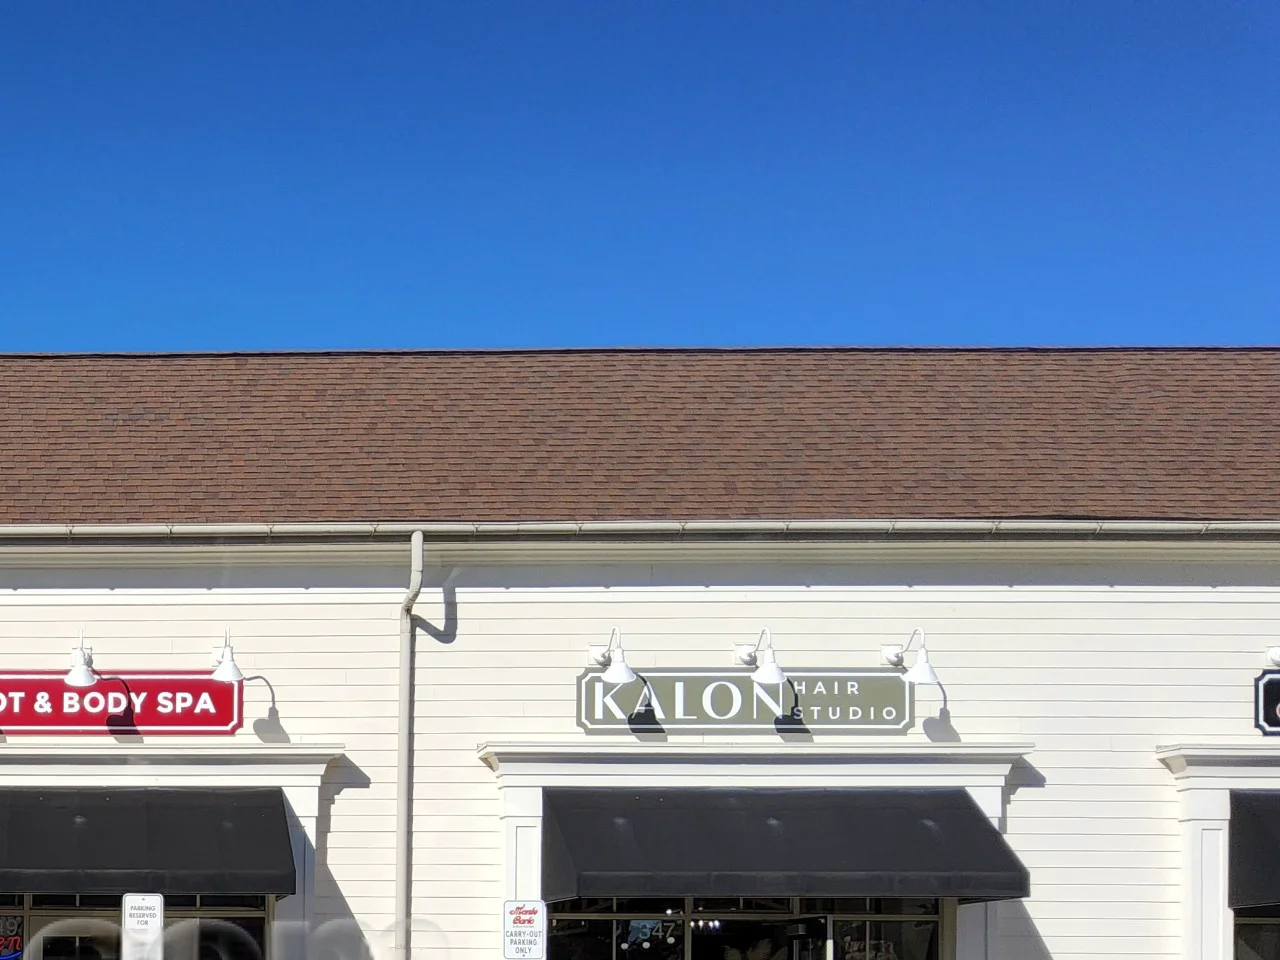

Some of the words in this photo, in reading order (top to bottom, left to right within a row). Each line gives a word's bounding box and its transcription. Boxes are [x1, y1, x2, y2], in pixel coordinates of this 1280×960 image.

[33, 692, 53, 713] &
[63, 692, 148, 713] BODY
[157, 692, 216, 713] SPA
[593, 681, 783, 720] KALON
[794, 681, 861, 695] HAIR
[793, 706, 897, 720] STUDIO
[640, 922, 676, 939] 347
